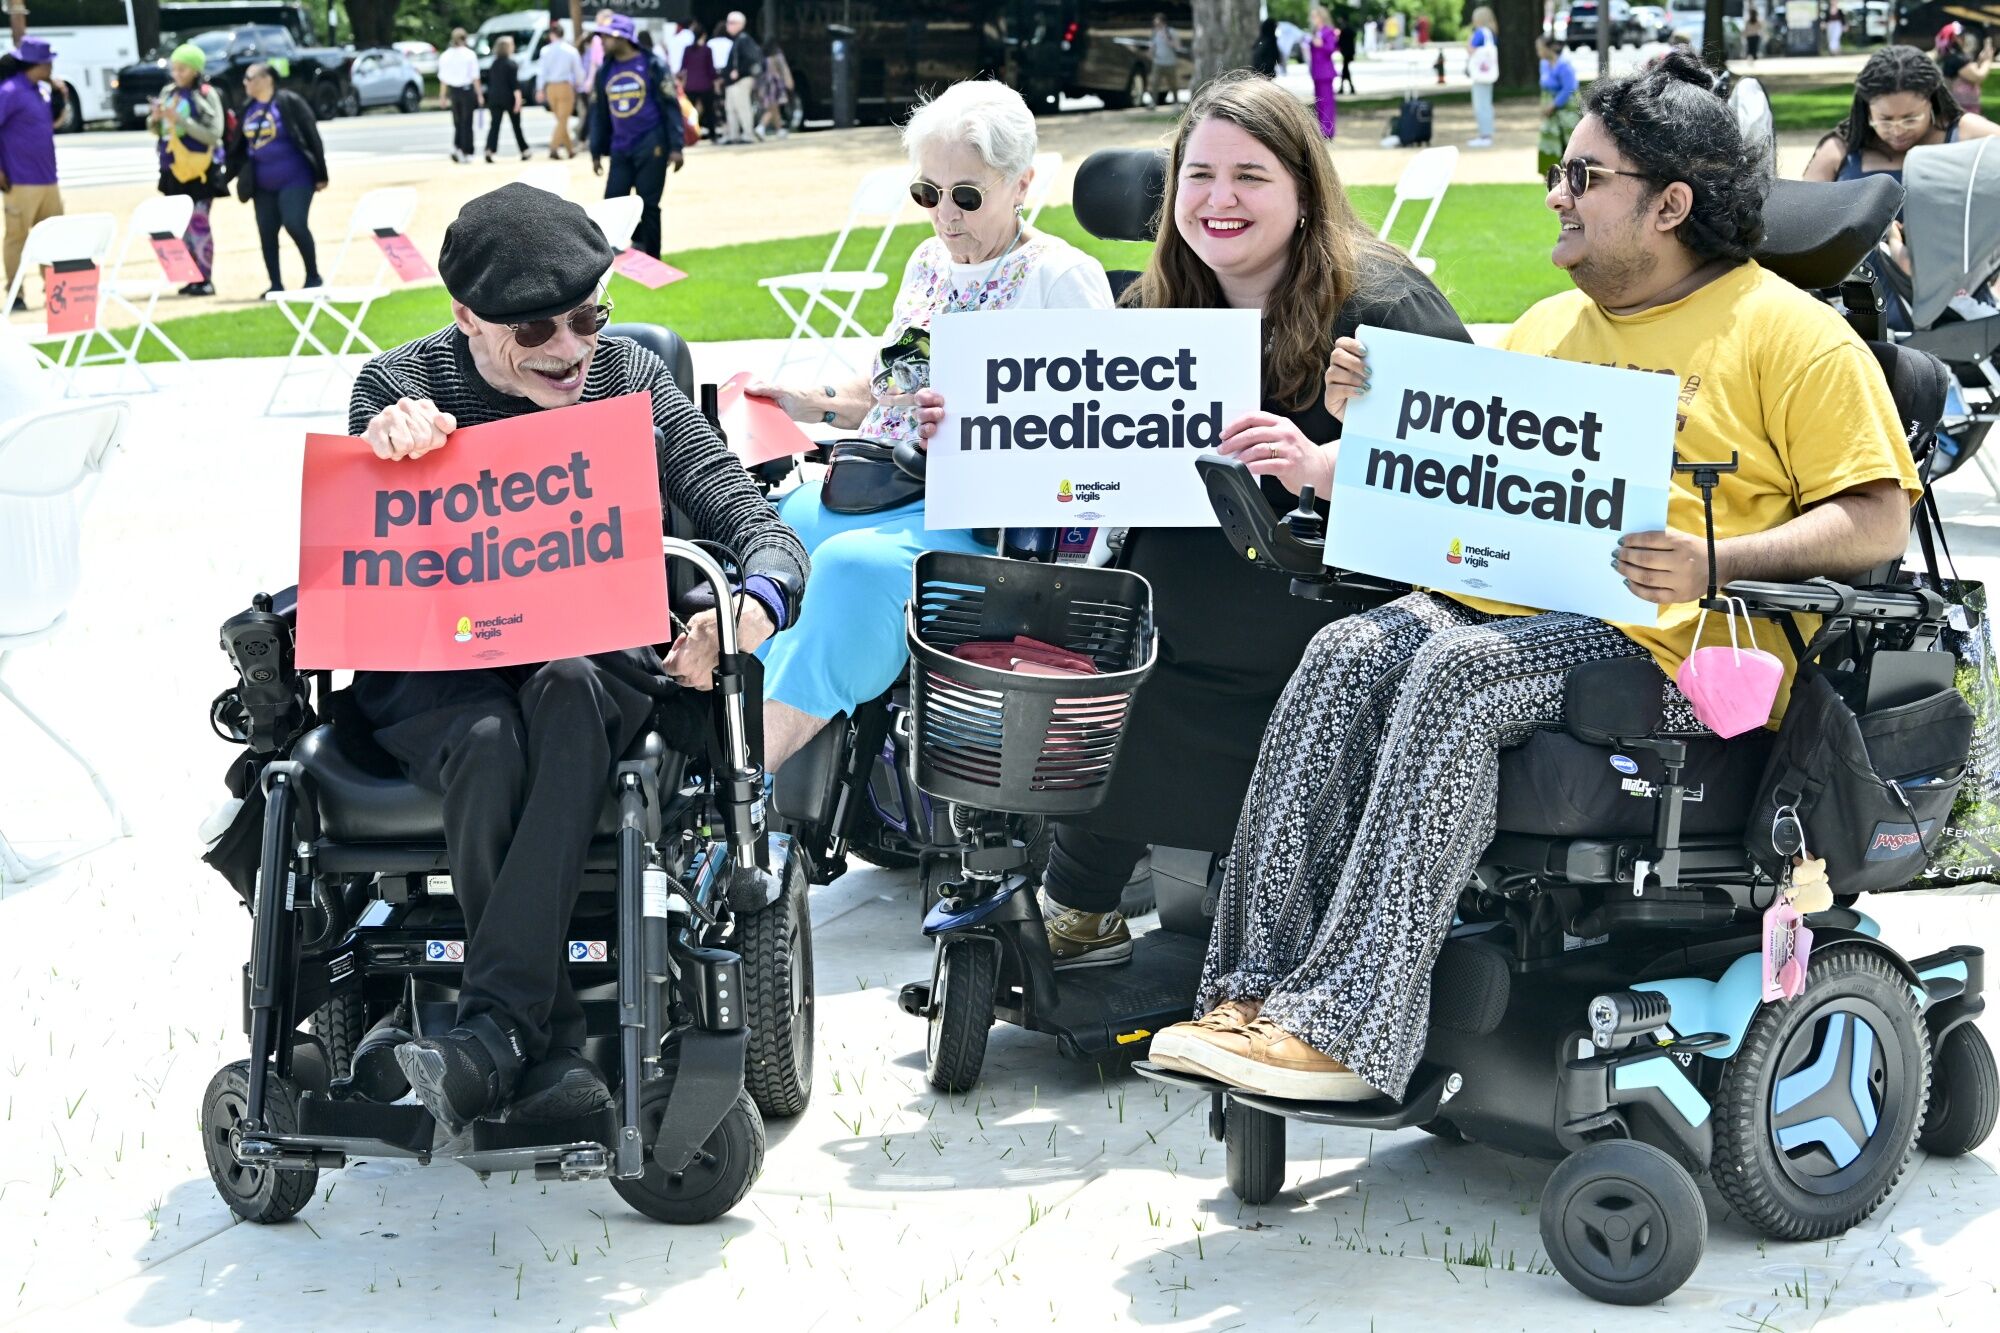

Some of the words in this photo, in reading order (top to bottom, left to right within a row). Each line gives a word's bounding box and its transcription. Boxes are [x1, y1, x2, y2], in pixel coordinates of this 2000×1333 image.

[986, 349, 1197, 404] protect
[960, 399, 1223, 451] medicaid
[1396, 388, 1602, 462] protect
[375, 451, 593, 537] protect
[1075, 481, 1120, 491] medicaid
[1365, 447, 1626, 532] medicaid
[1075, 491, 1101, 502] vigils
[342, 506, 624, 587] medicaid
[1465, 545, 1510, 561] medicaid
[1464, 555, 1489, 568] vigils
[475, 614, 523, 628] medicaid
[475, 627, 502, 640] vigils
[1944, 863, 1995, 879] Giant
